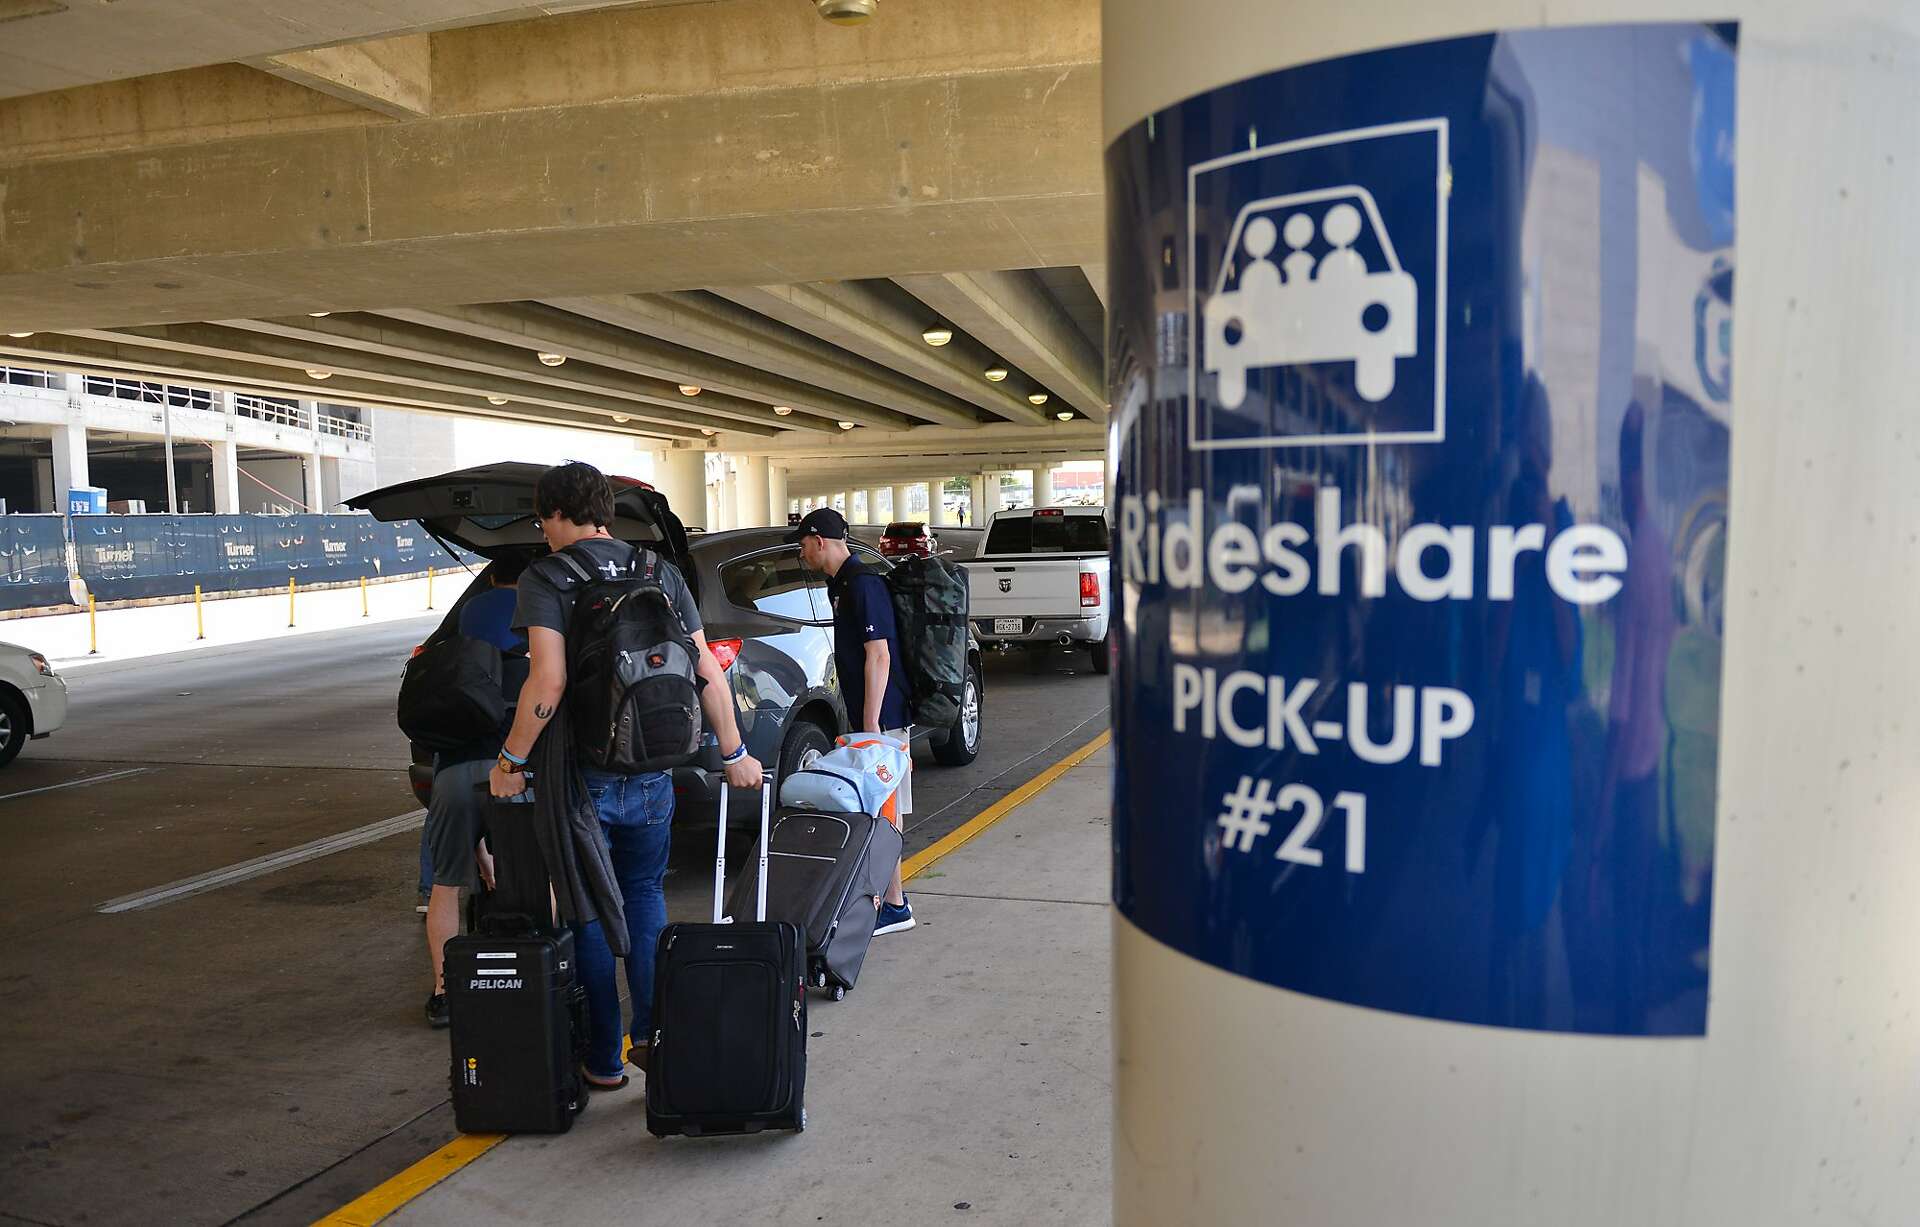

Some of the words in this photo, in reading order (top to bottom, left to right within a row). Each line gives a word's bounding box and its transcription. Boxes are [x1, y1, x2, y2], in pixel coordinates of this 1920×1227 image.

[225, 541, 255, 556] Turner
[322, 538, 347, 552] Turner
[1121, 486, 1628, 605] Rideshare
[95, 547, 134, 563] Turner
[1172, 663, 1475, 767] PICK-UP
[1216, 775, 1367, 874] #21
[470, 979, 522, 989] PELICAN
